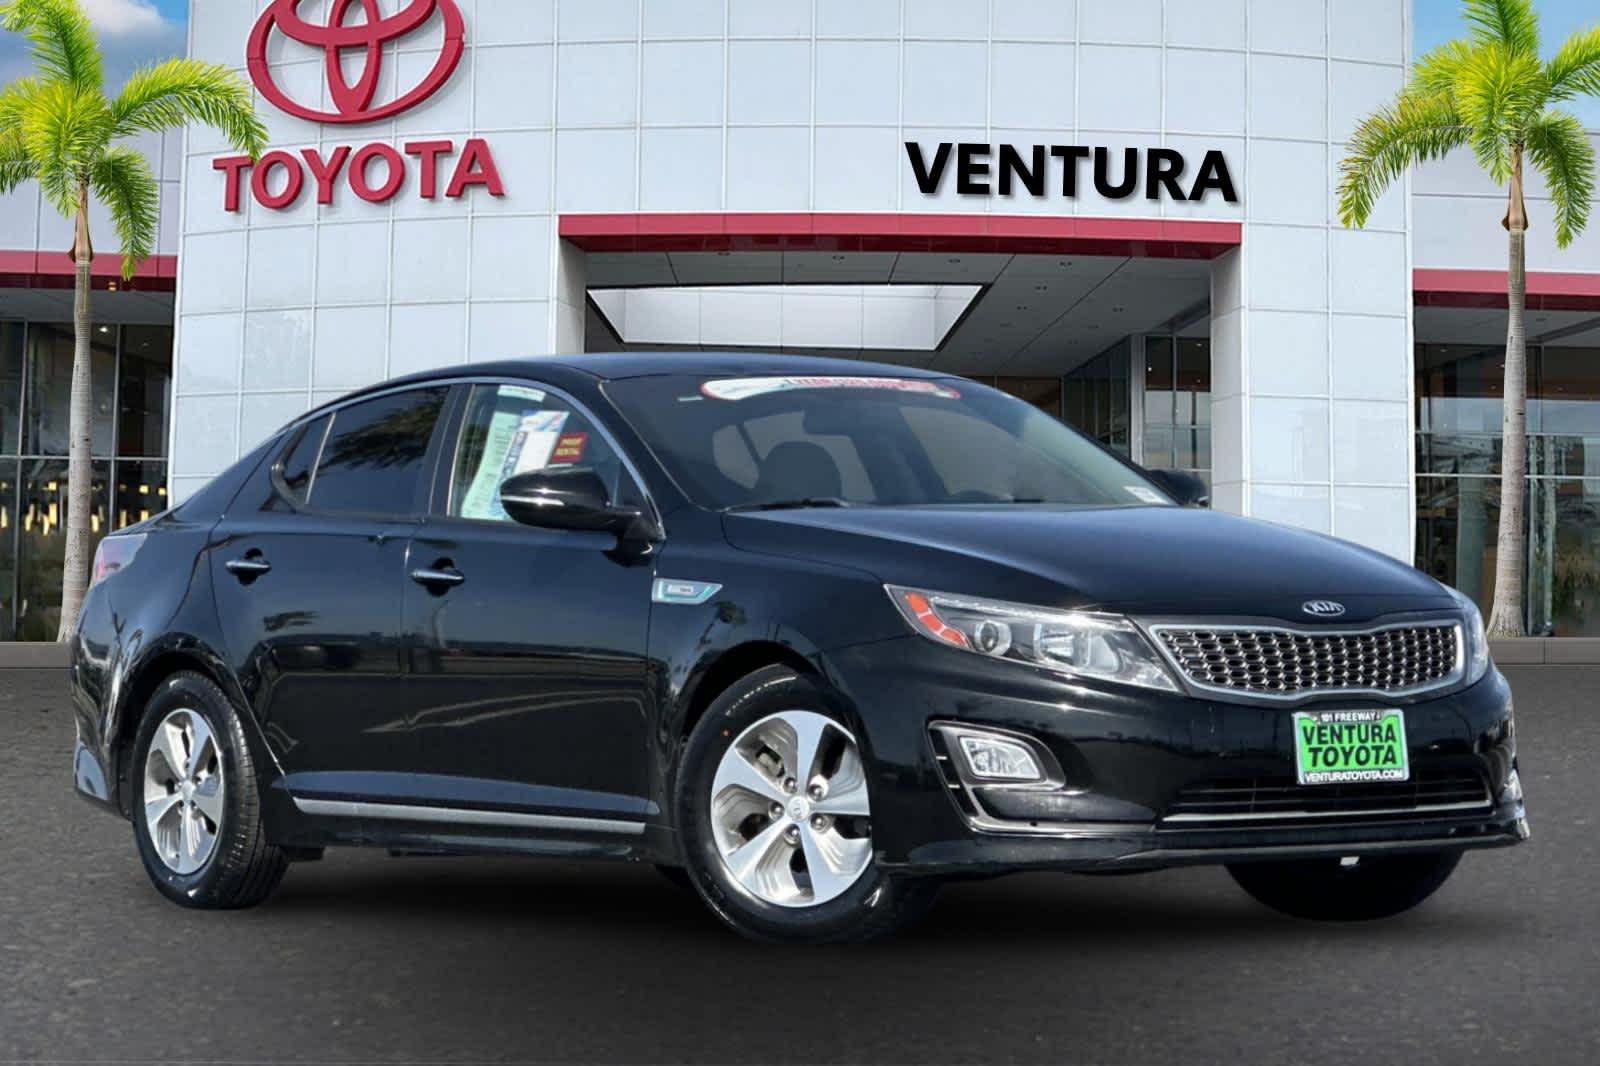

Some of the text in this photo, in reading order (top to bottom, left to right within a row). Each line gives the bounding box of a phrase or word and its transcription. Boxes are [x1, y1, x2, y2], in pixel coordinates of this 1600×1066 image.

[212, 138, 505, 212] TOYOTA
[904, 142, 1238, 202] VENTURA
[1335, 711, 1376, 721] FREEWAY
[1302, 723, 1397, 745] VENTURA
[1308, 745, 1397, 768] TOYOTA
[1304, 769, 1403, 783] VENTURATOYOTA.COM
